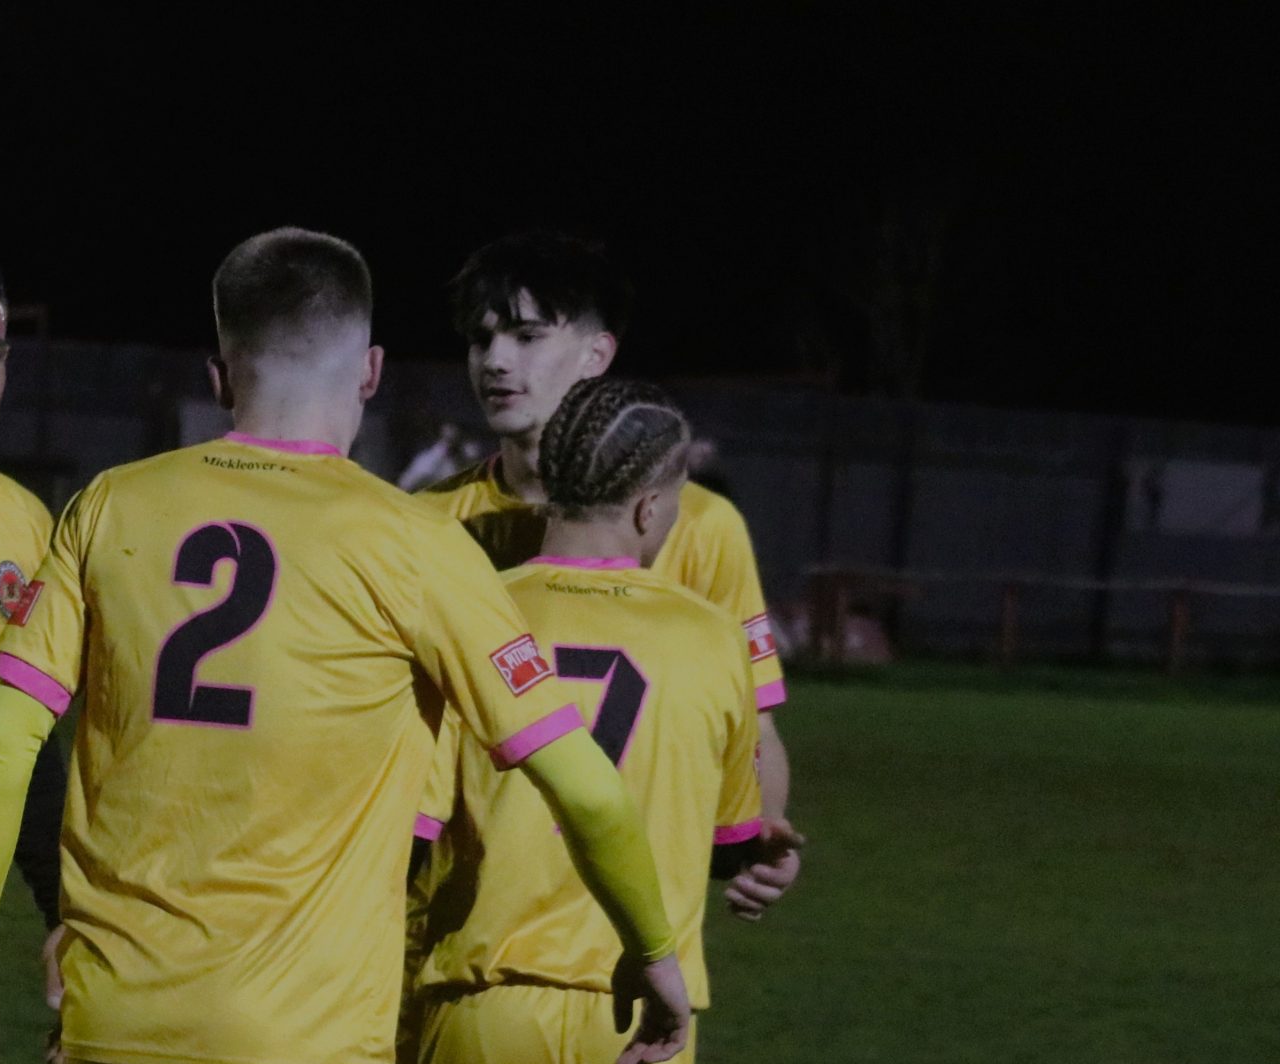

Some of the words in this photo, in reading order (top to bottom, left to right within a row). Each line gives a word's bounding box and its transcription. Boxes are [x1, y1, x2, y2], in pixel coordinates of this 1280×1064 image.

[201, 455, 278, 471] Mickleover
[151, 519, 281, 732] 2
[613, 585, 632, 597] FC
[551, 643, 651, 771] 7
